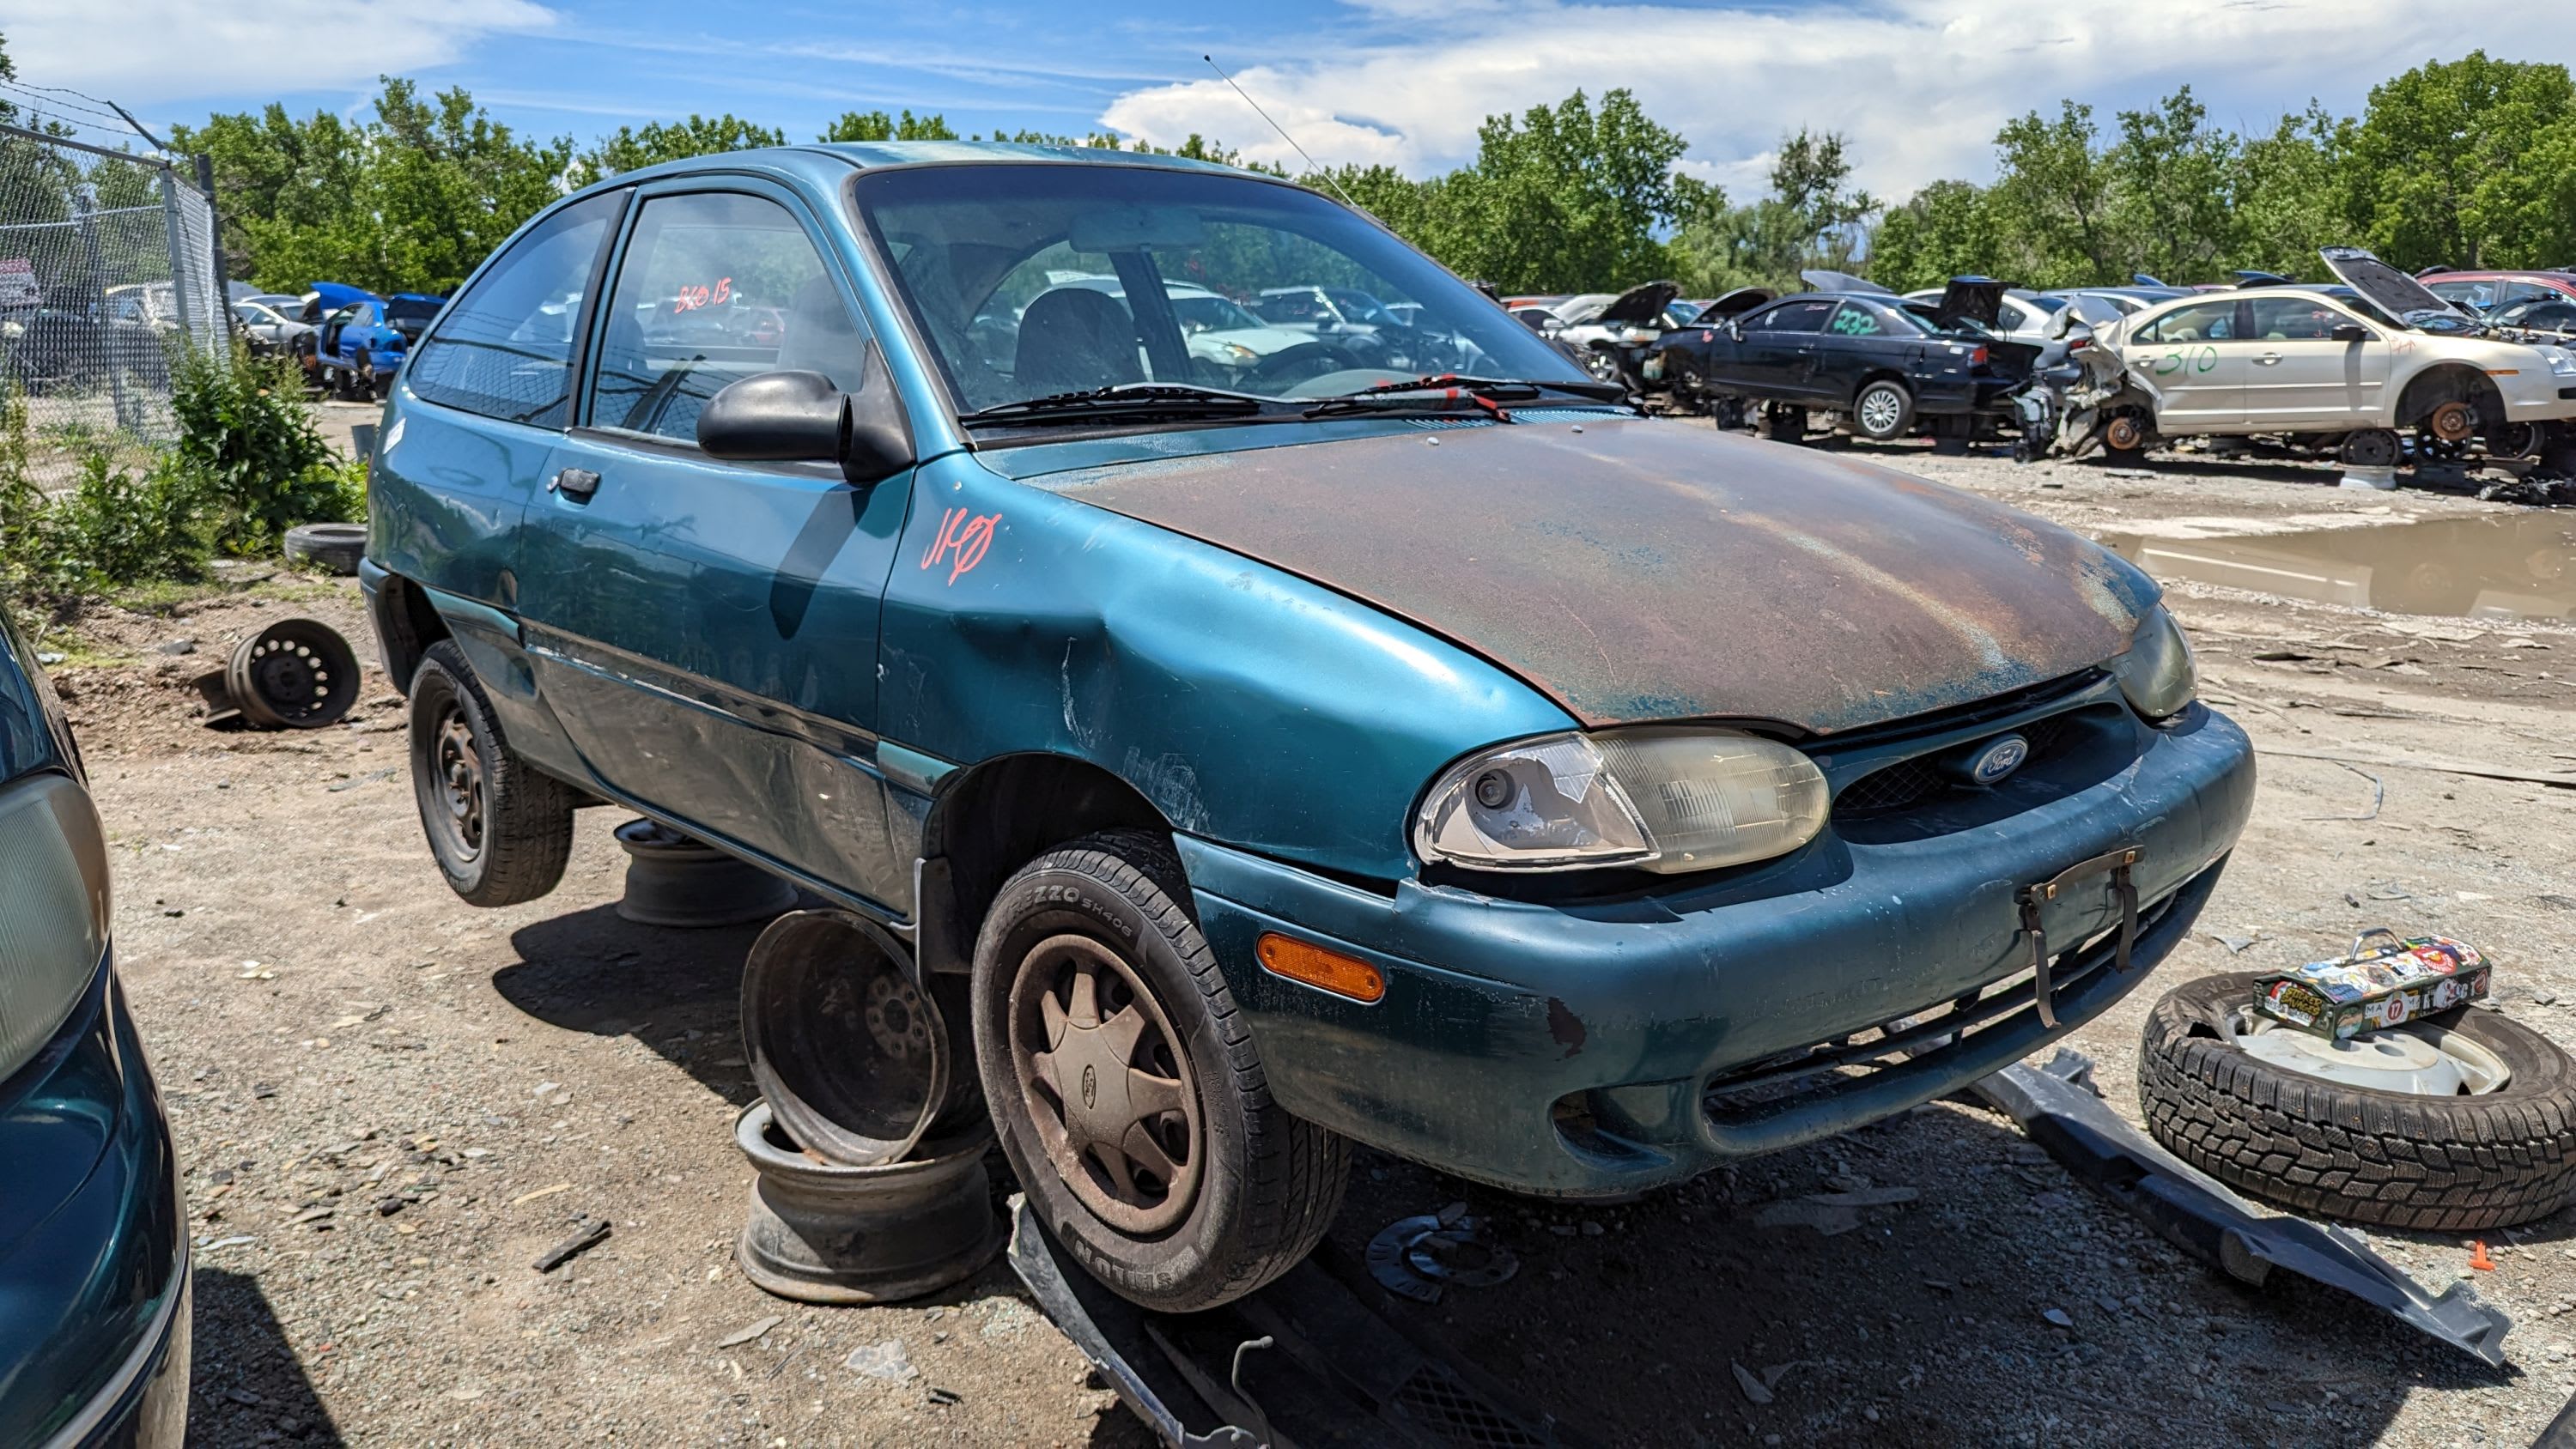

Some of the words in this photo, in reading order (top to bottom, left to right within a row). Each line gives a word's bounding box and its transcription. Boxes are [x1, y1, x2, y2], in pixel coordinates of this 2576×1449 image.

[1834, 308, 1880, 335] 232
[2155, 345, 2218, 376] 310
[1987, 749, 2017, 773] Ford
[1080, 897, 1133, 938] SH406
[2391, 1001, 2401, 1018] 17
